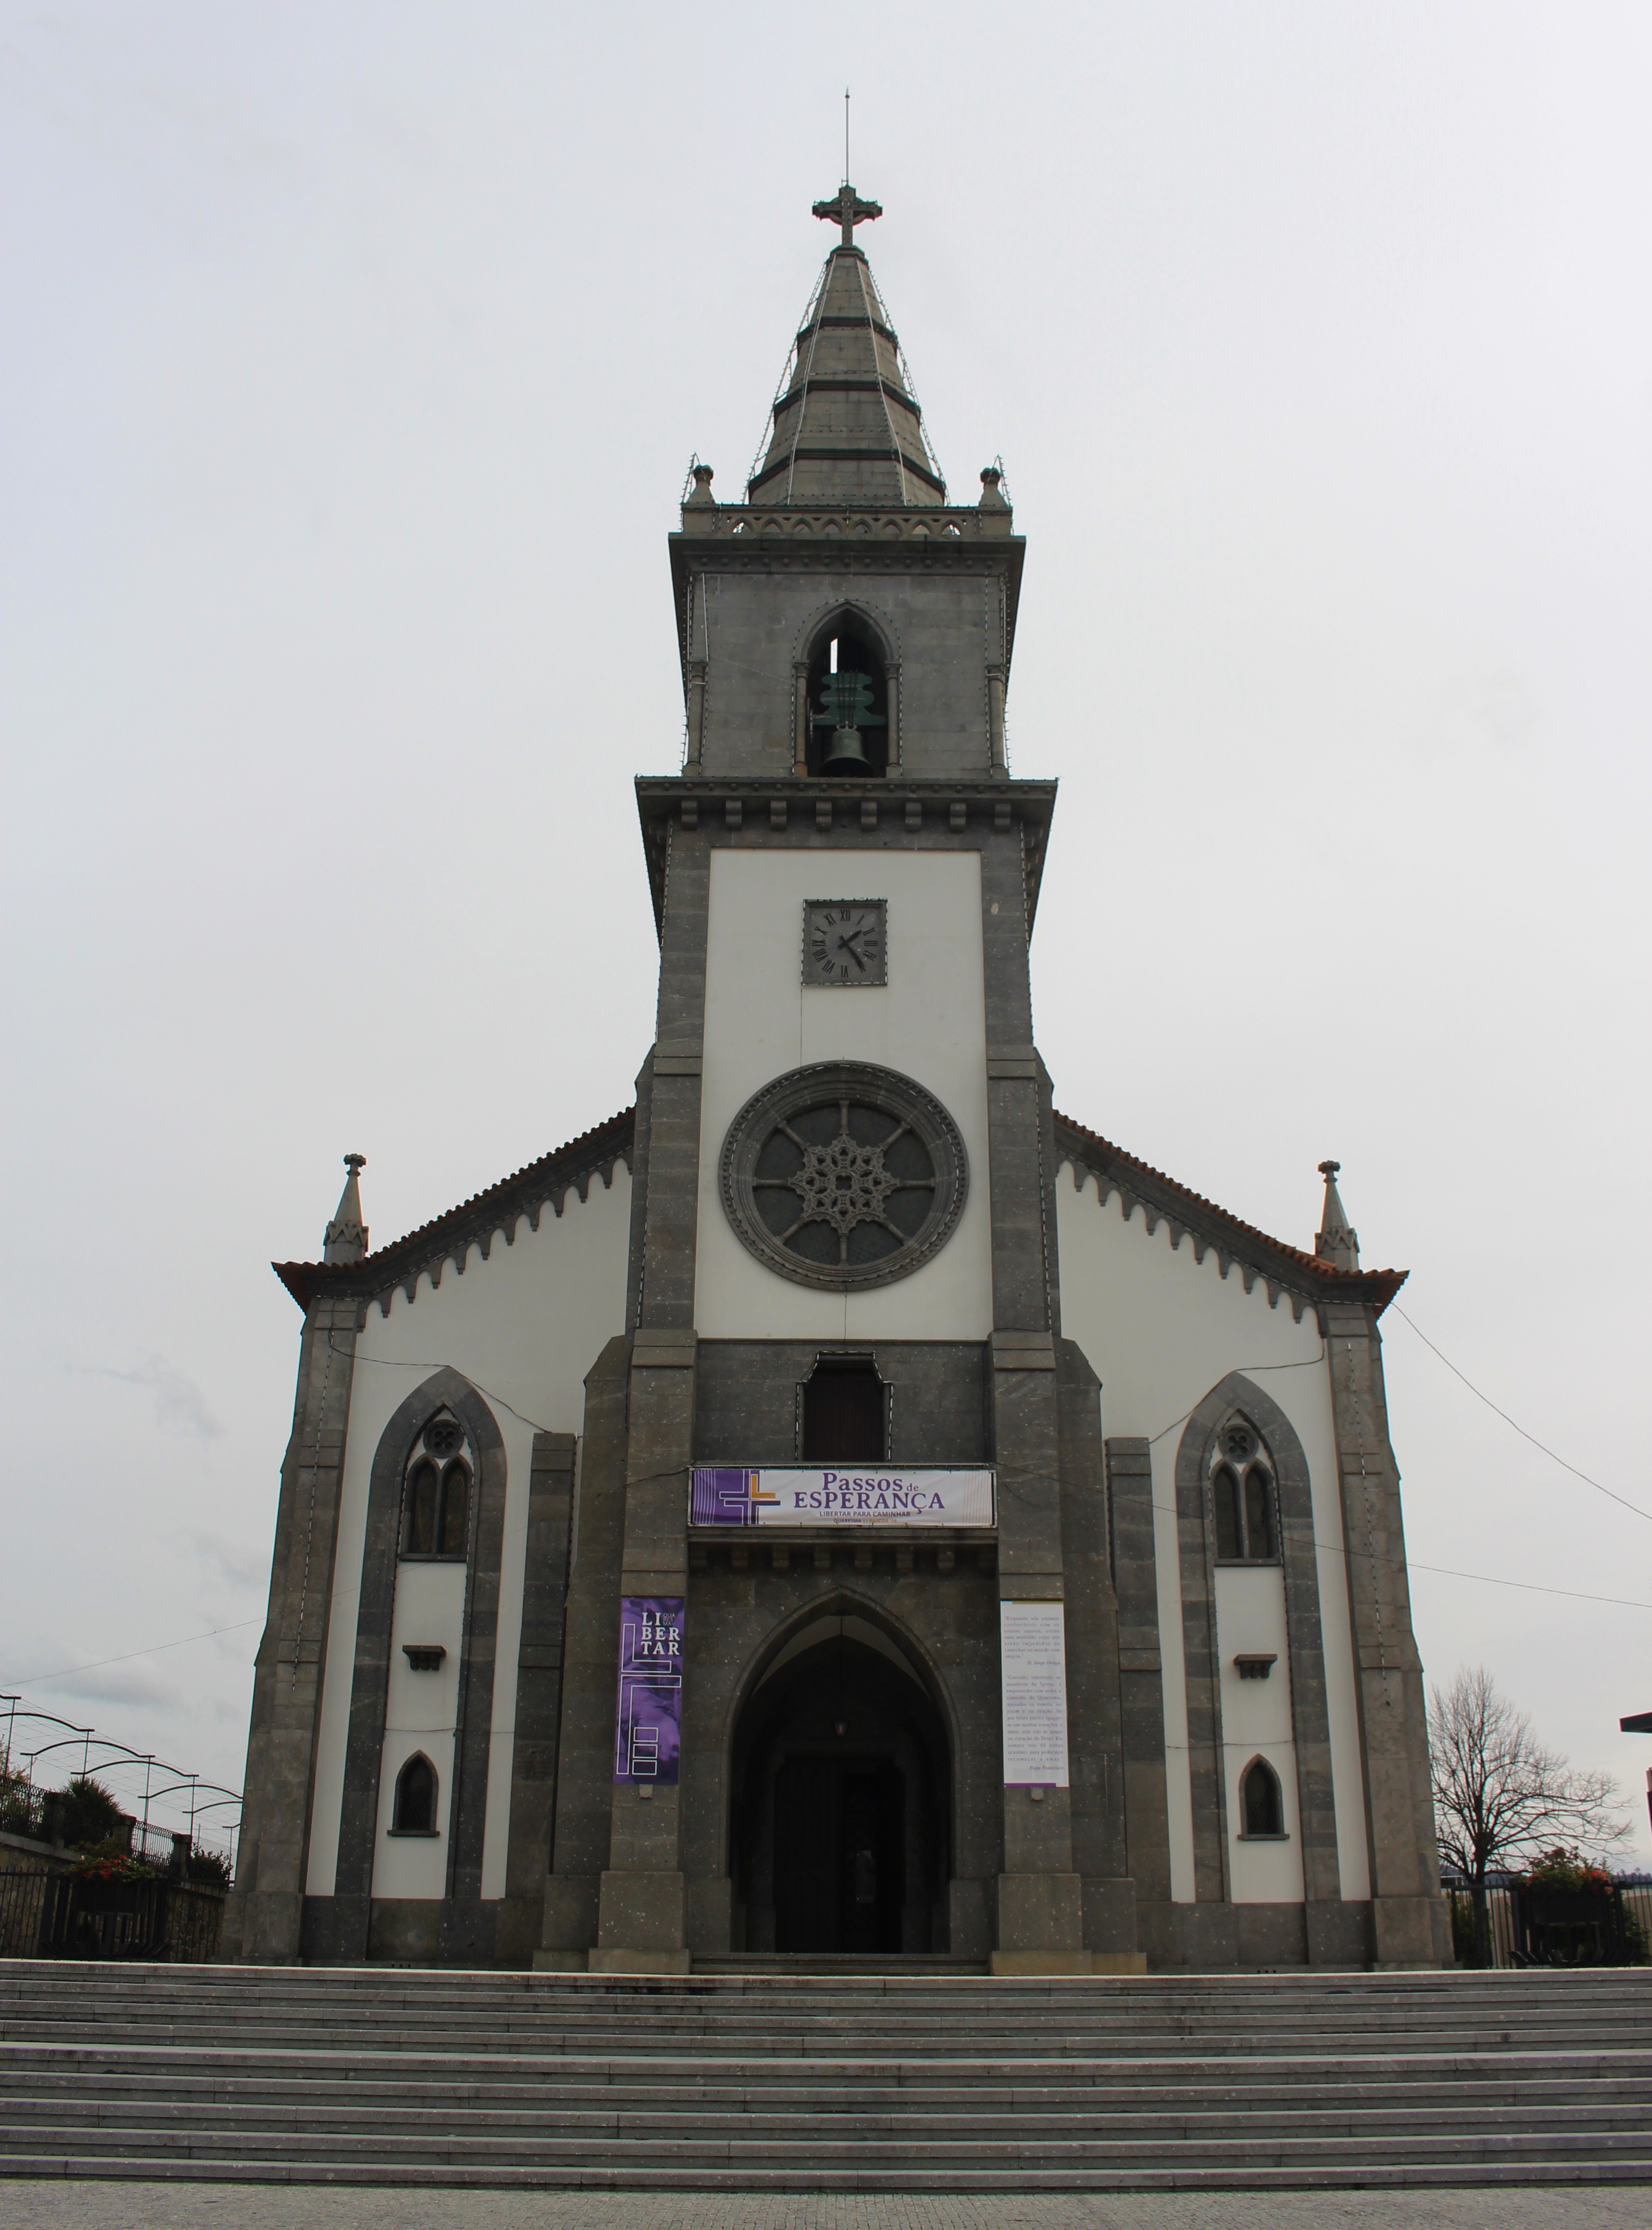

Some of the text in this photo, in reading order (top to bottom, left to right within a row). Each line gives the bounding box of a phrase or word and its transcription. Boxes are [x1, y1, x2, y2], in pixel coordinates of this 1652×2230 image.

[824, 913, 836, 926] XI
[840, 909, 851, 922] XII
[814, 926, 827, 936] X
[863, 927, 875, 936] II
[813, 948, 828, 962] VIII
[863, 950, 876, 961] IV
[822, 960, 836, 974] VII
[841, 965, 848, 977] VI
[822, 1473, 919, 1491] Passos de
[794, 1491, 945, 1514] ESPERANÇA
[642, 1612, 661, 1626] LI
[641, 1627, 680, 1640] BER
[641, 1641, 680, 1655] TAR
